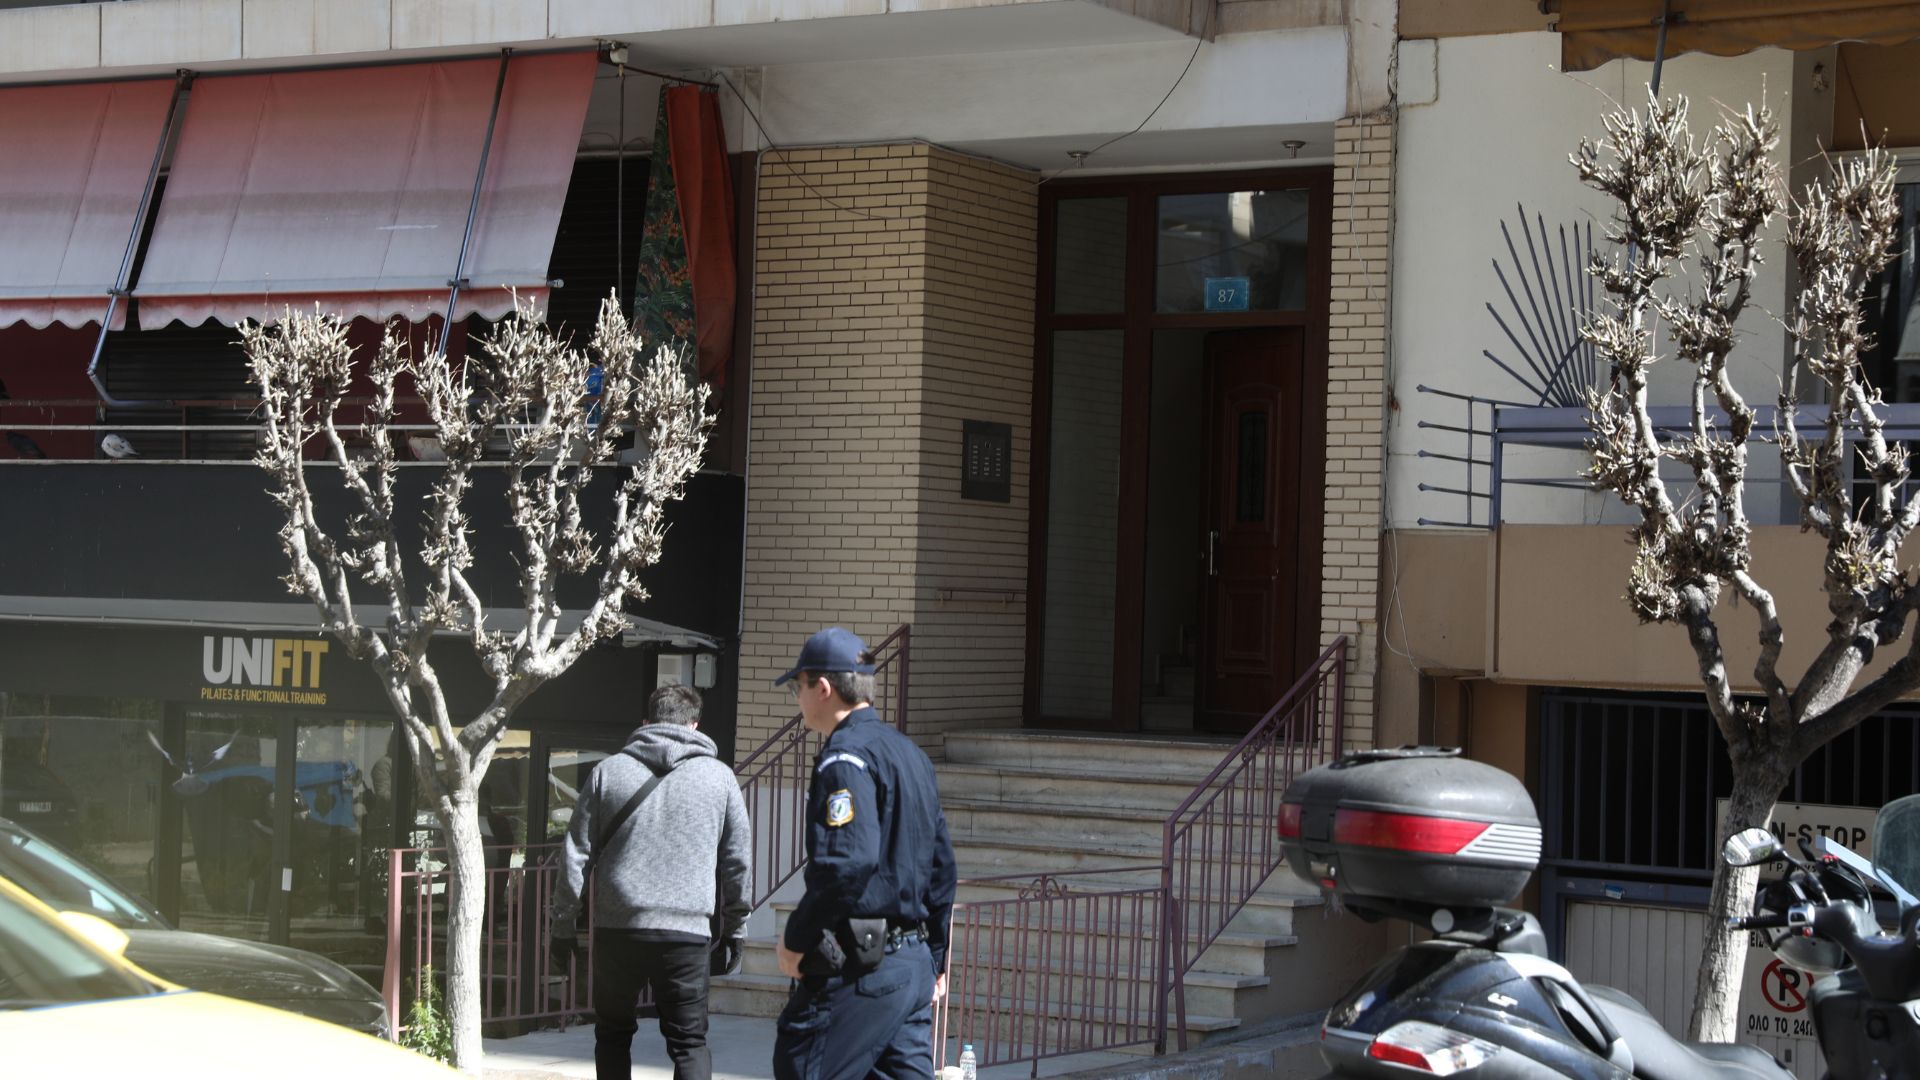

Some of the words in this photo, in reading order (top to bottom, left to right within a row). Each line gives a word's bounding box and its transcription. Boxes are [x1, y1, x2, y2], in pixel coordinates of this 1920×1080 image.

[1218, 288, 1235, 303] 87
[202, 635, 329, 688] UNIFIT
[201, 687, 233, 701] PILATES
[234, 689, 240, 702] &
[241, 690, 289, 703] FUNCTIONAL
[291, 691, 327, 705] TRAINING
[1771, 821, 1866, 850] N-STOP
[1748, 1014, 1769, 1031] ΟΛΟ
[1775, 1017, 1788, 1034] ΤΟ
[1793, 1019, 1813, 1037] 24Ω
